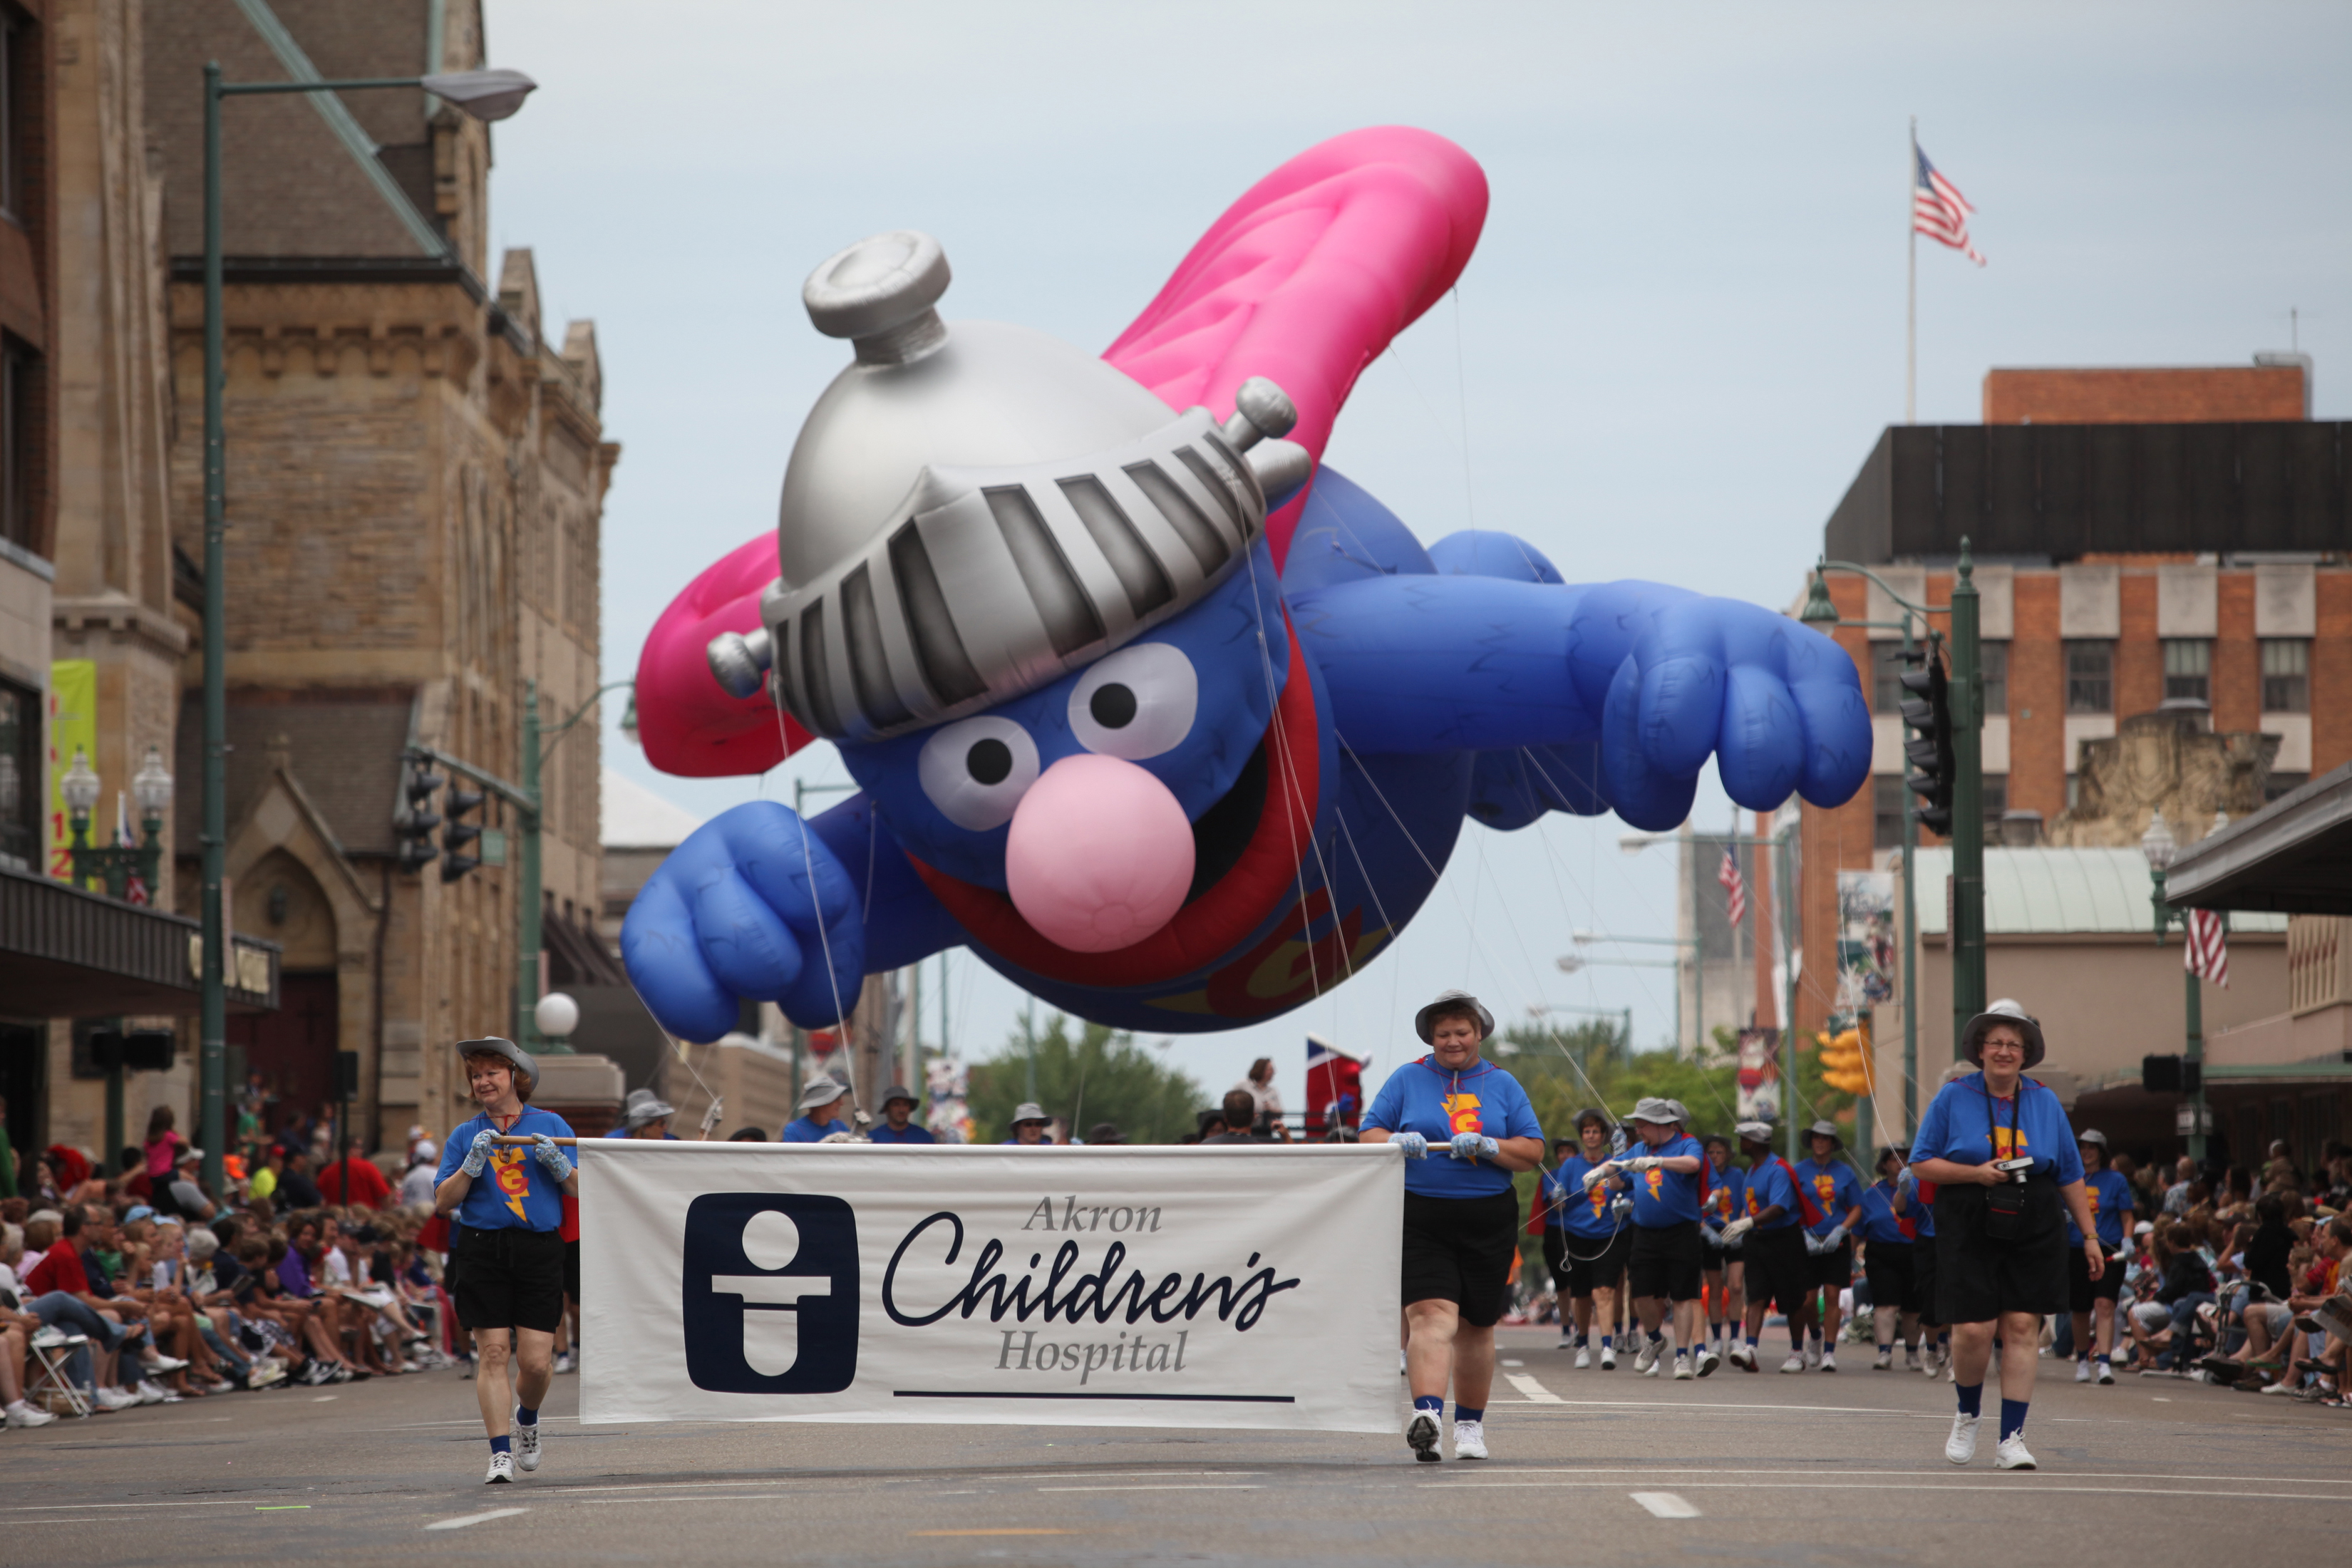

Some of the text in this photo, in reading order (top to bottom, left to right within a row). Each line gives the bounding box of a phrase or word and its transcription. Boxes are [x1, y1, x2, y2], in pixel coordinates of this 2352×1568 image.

[1449, 1108, 1484, 1135] G
[495, 1163, 529, 1195] G
[1645, 1167, 1664, 1185] G
[1021, 1195, 1162, 1233] Akron
[882, 1212, 1301, 1332] Children's
[996, 1329, 1187, 1386] Hospital
